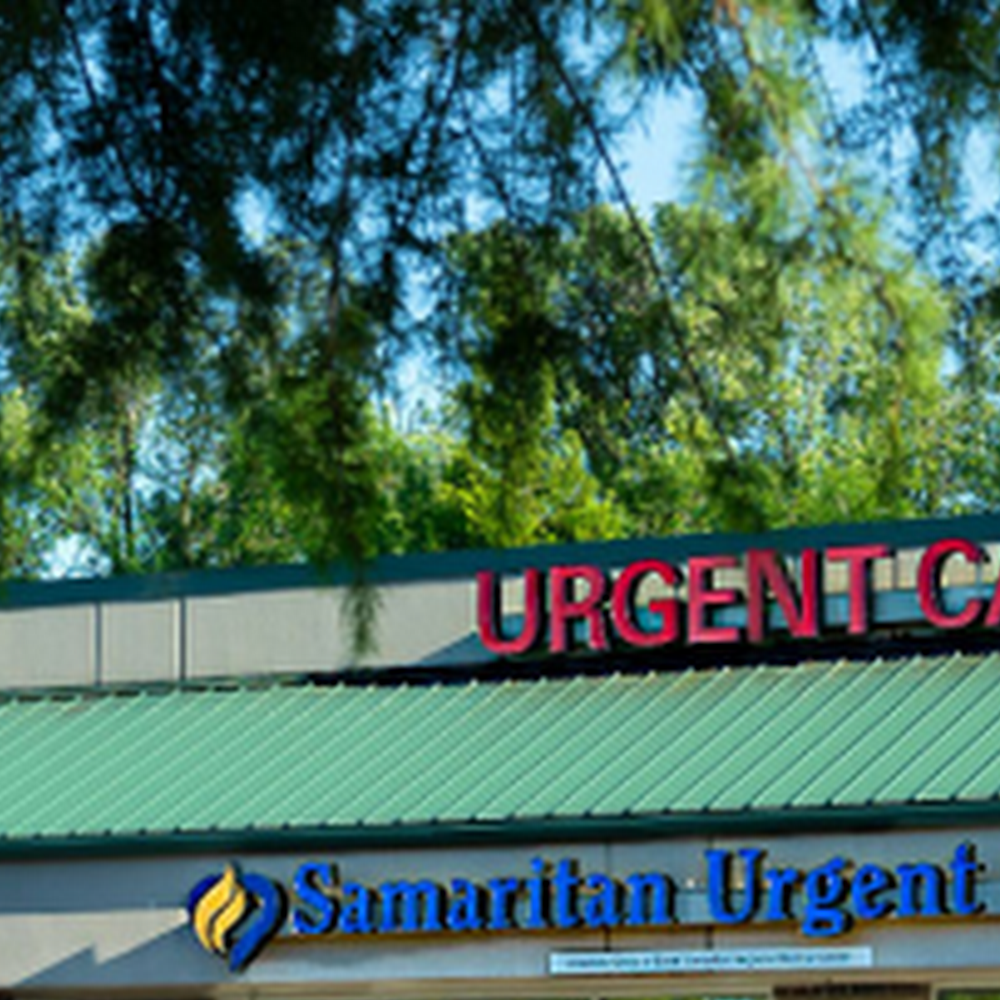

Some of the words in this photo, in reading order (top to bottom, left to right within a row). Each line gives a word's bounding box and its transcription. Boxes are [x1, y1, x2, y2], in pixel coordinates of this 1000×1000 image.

[475, 543, 890, 655] URGENT
[292, 858, 675, 935] Samaritan
[705, 841, 986, 937] Urgent
